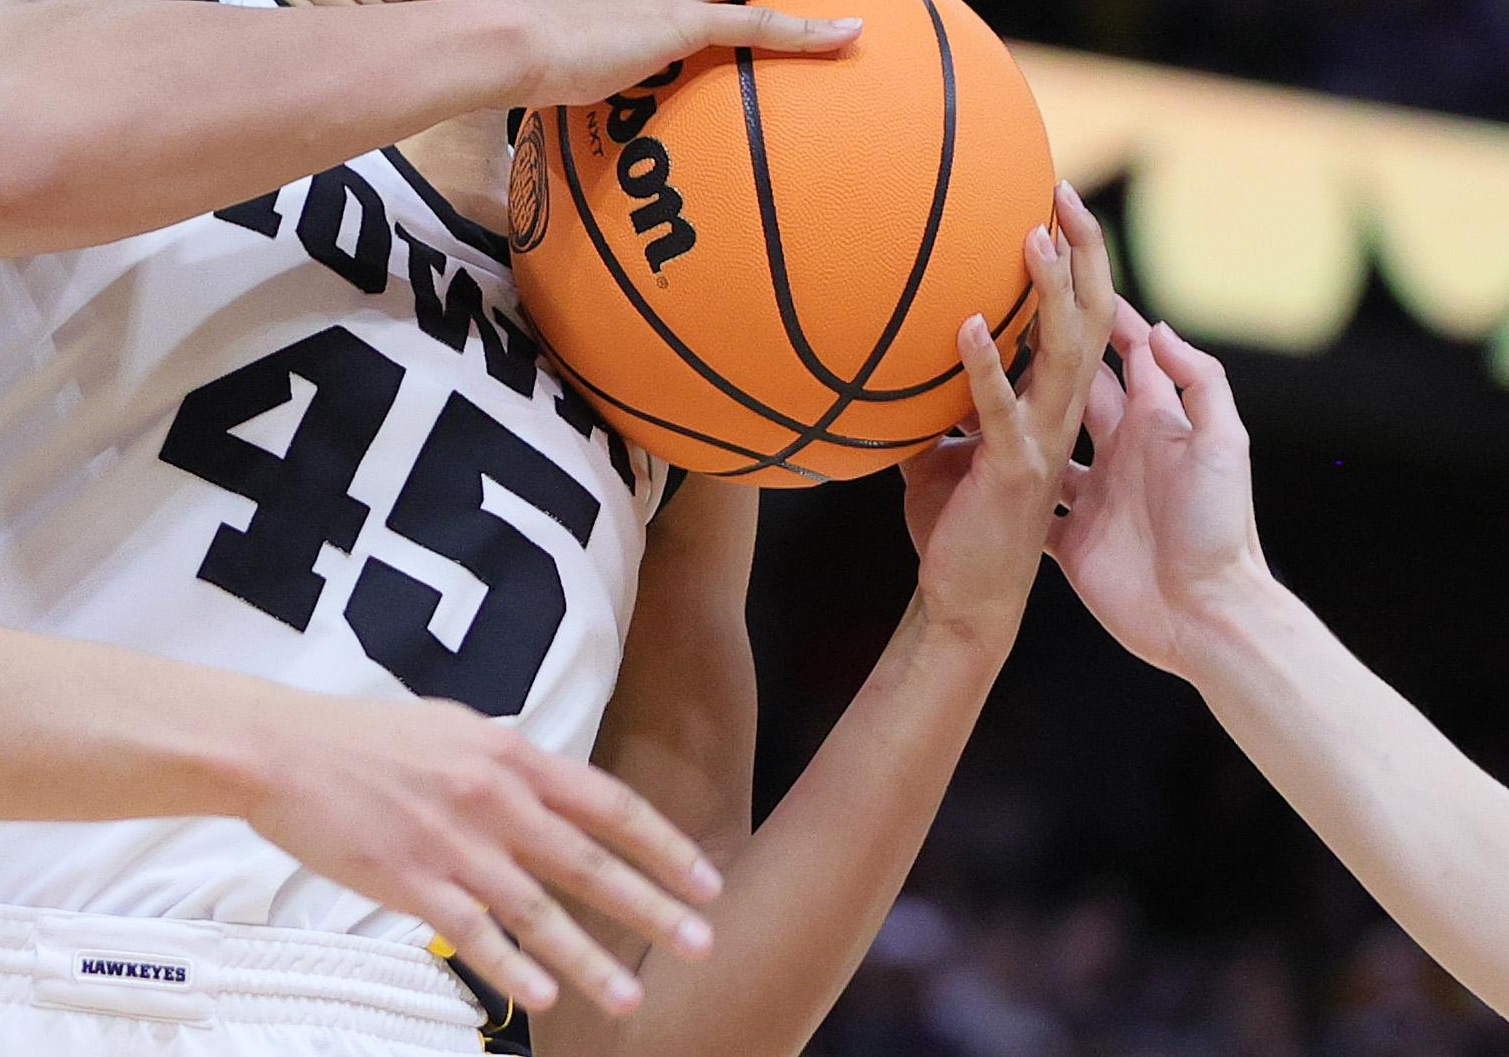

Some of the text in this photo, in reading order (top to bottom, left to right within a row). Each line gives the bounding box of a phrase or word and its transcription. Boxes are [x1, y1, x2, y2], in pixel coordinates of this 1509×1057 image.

[586, 111, 604, 157] NXT
[159, 325, 601, 717] 45
[81, 957, 187, 983] HAWKEYES
